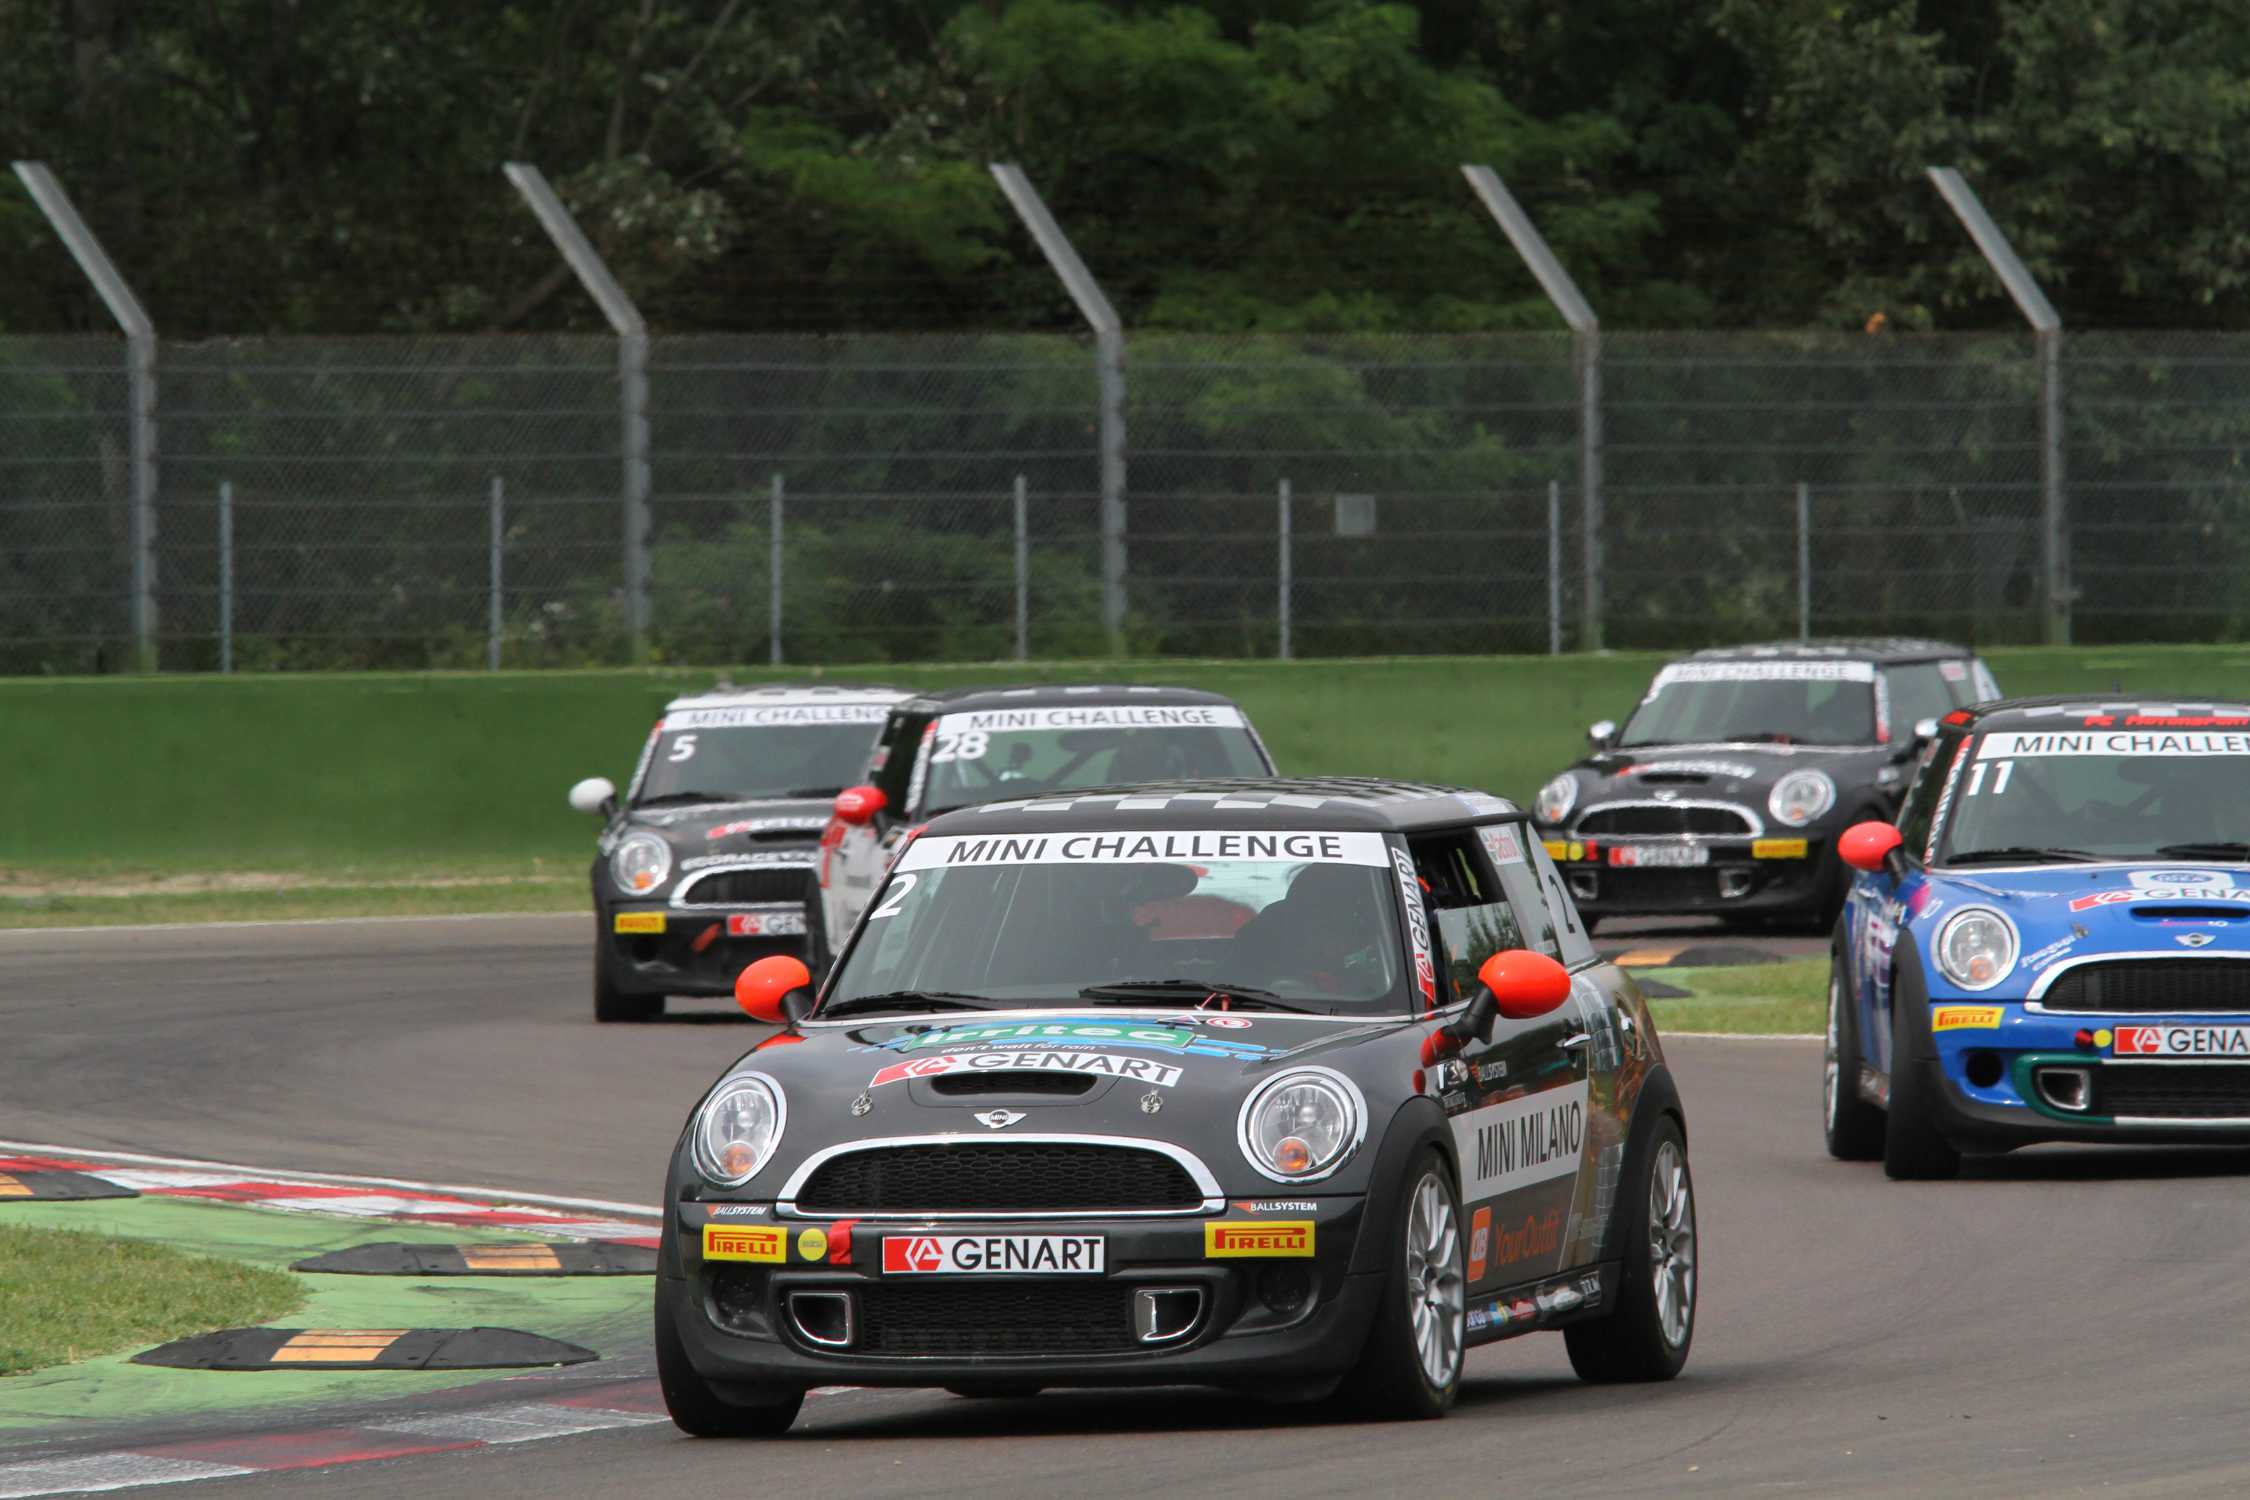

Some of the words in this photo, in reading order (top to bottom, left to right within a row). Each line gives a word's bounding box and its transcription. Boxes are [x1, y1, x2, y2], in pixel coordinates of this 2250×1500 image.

[688, 710, 745, 724] MINI
[970, 711, 1035, 729] MINI
[1047, 708, 1217, 727] CHALLENGE
[668, 735, 697, 762] 5
[931, 731, 988, 763] 28
[2013, 736, 2092, 753] MINI
[1968, 761, 2014, 796] 11
[946, 838, 1049, 864] MINI
[1061, 835, 1343, 860] CHALLENGE
[869, 873, 917, 920] 2
[1396, 848, 1430, 951] GENART
[1549, 874, 1576, 934] 2
[1937, 1009, 1996, 1026] PIRELLI
[923, 1025, 1178, 1044] irritec
[2167, 1028, 2249, 1053] GENA
[968, 1053, 1178, 1083] GENART
[1477, 1119, 1516, 1181] MINI
[1520, 1100, 1581, 1169] MILANO
[1249, 1201, 1318, 1212] BALLSYSTEM
[708, 1231, 778, 1255] PIRELLI
[1215, 1227, 1307, 1249] PIRELLI
[952, 1238, 1101, 1270] GENART
